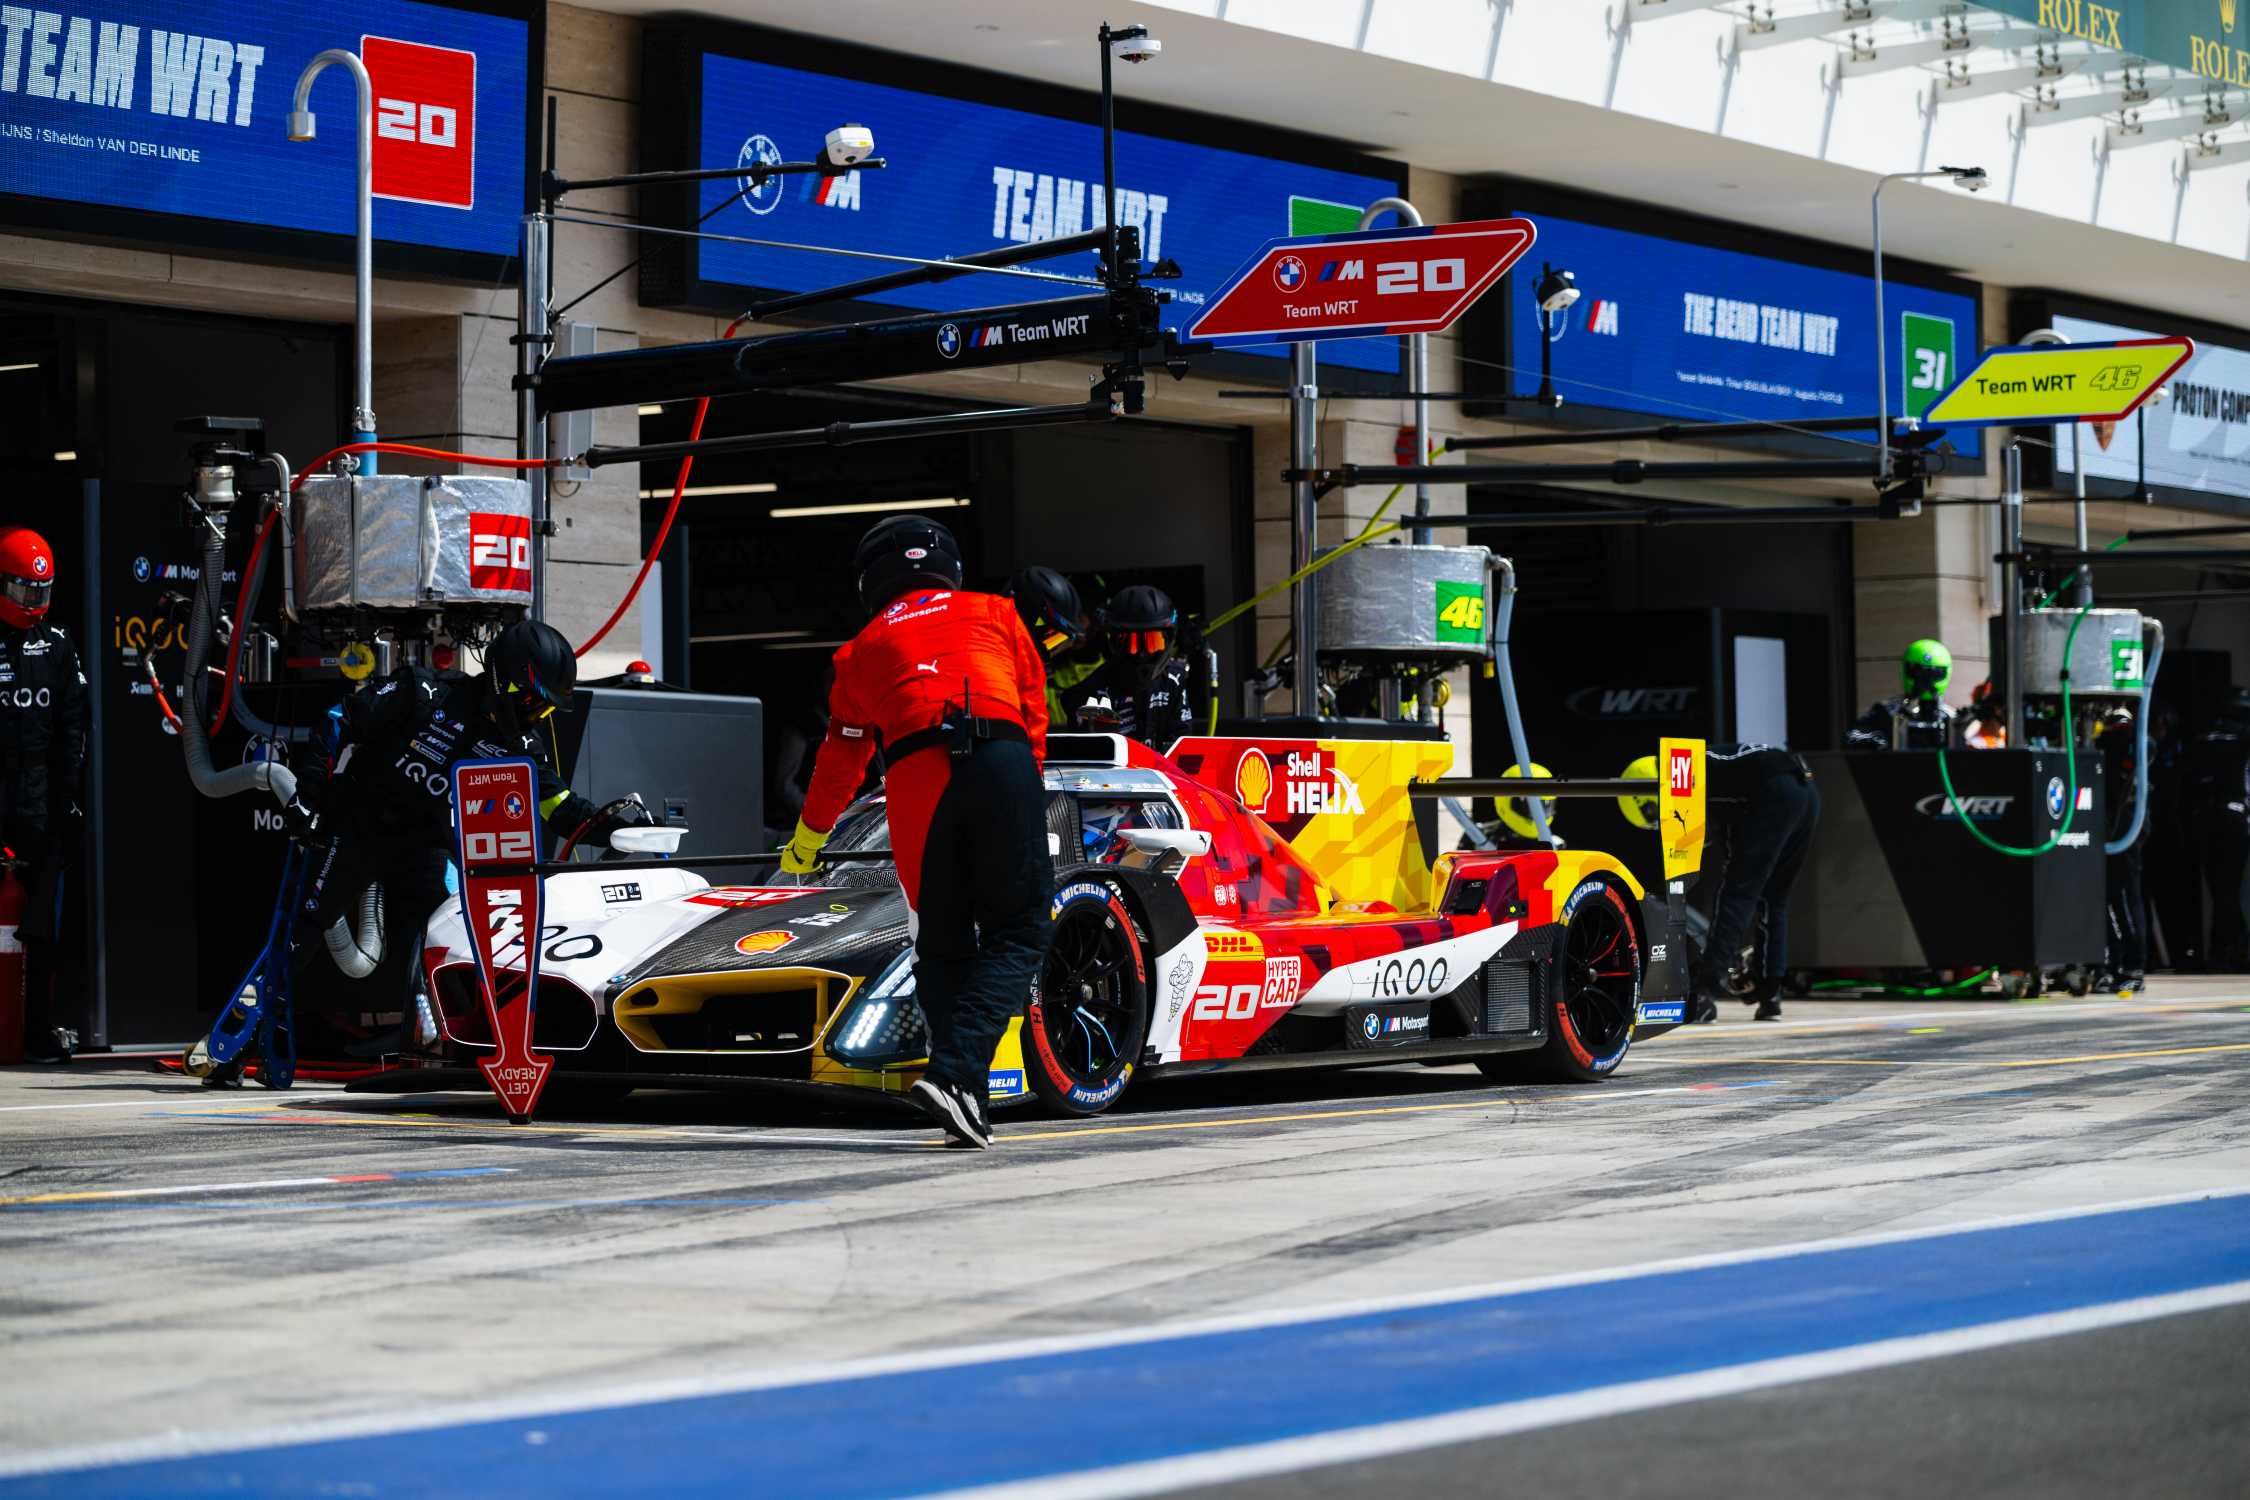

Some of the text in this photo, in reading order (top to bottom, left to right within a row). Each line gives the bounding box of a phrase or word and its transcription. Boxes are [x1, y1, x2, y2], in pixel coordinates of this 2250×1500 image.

[2038, 0, 2122, 49] ROLEX
[1, 5, 265, 127] TEAM WRT
[378, 98, 457, 148] 20
[0, 123, 33, 140] IJNS
[42, 129, 94, 149] Sheldon
[97, 136, 125, 153] VAN
[129, 141, 157, 157] DER
[160, 145, 200, 163] LINDE
[993, 166, 1085, 244] TEAM
[1377, 259, 1465, 294] 20
[1283, 300, 1359, 318] Team WRT
[1008, 324, 1049, 342] Team
[1052, 315, 1089, 338] WRT
[1684, 292, 1839, 356] THE BEND TEAM WRT
[1911, 348, 1947, 391] 31
[1976, 365, 2142, 395] Team WRT 46
[2172, 381, 2218, 419] PROTON
[473, 534, 530, 569] 20
[888, 604, 949, 625] Motorsport
[1440, 597, 1484, 629] 46
[1287, 751, 1321, 777] Shell
[468, 773, 518, 786] Team WRT
[1286, 767, 1366, 815] HELIX
[466, 831, 532, 860] 20
[603, 886, 627, 900] 20
[1061, 882, 1107, 902] MICHELIN
[1204, 936, 1255, 953] DHL
[1651, 944, 1666, 956] OZ
[1267, 960, 1299, 978] HYPER
[1372, 957, 1448, 998] iQOO
[1193, 986, 1261, 1020] 20
[1264, 978, 1298, 1004] CAR
[1402, 1014, 1429, 1031] Motorsport
[1646, 1008, 1682, 1018] MICHELIN
[497, 1067, 537, 1080] READY
[506, 1082, 531, 1095] GET
